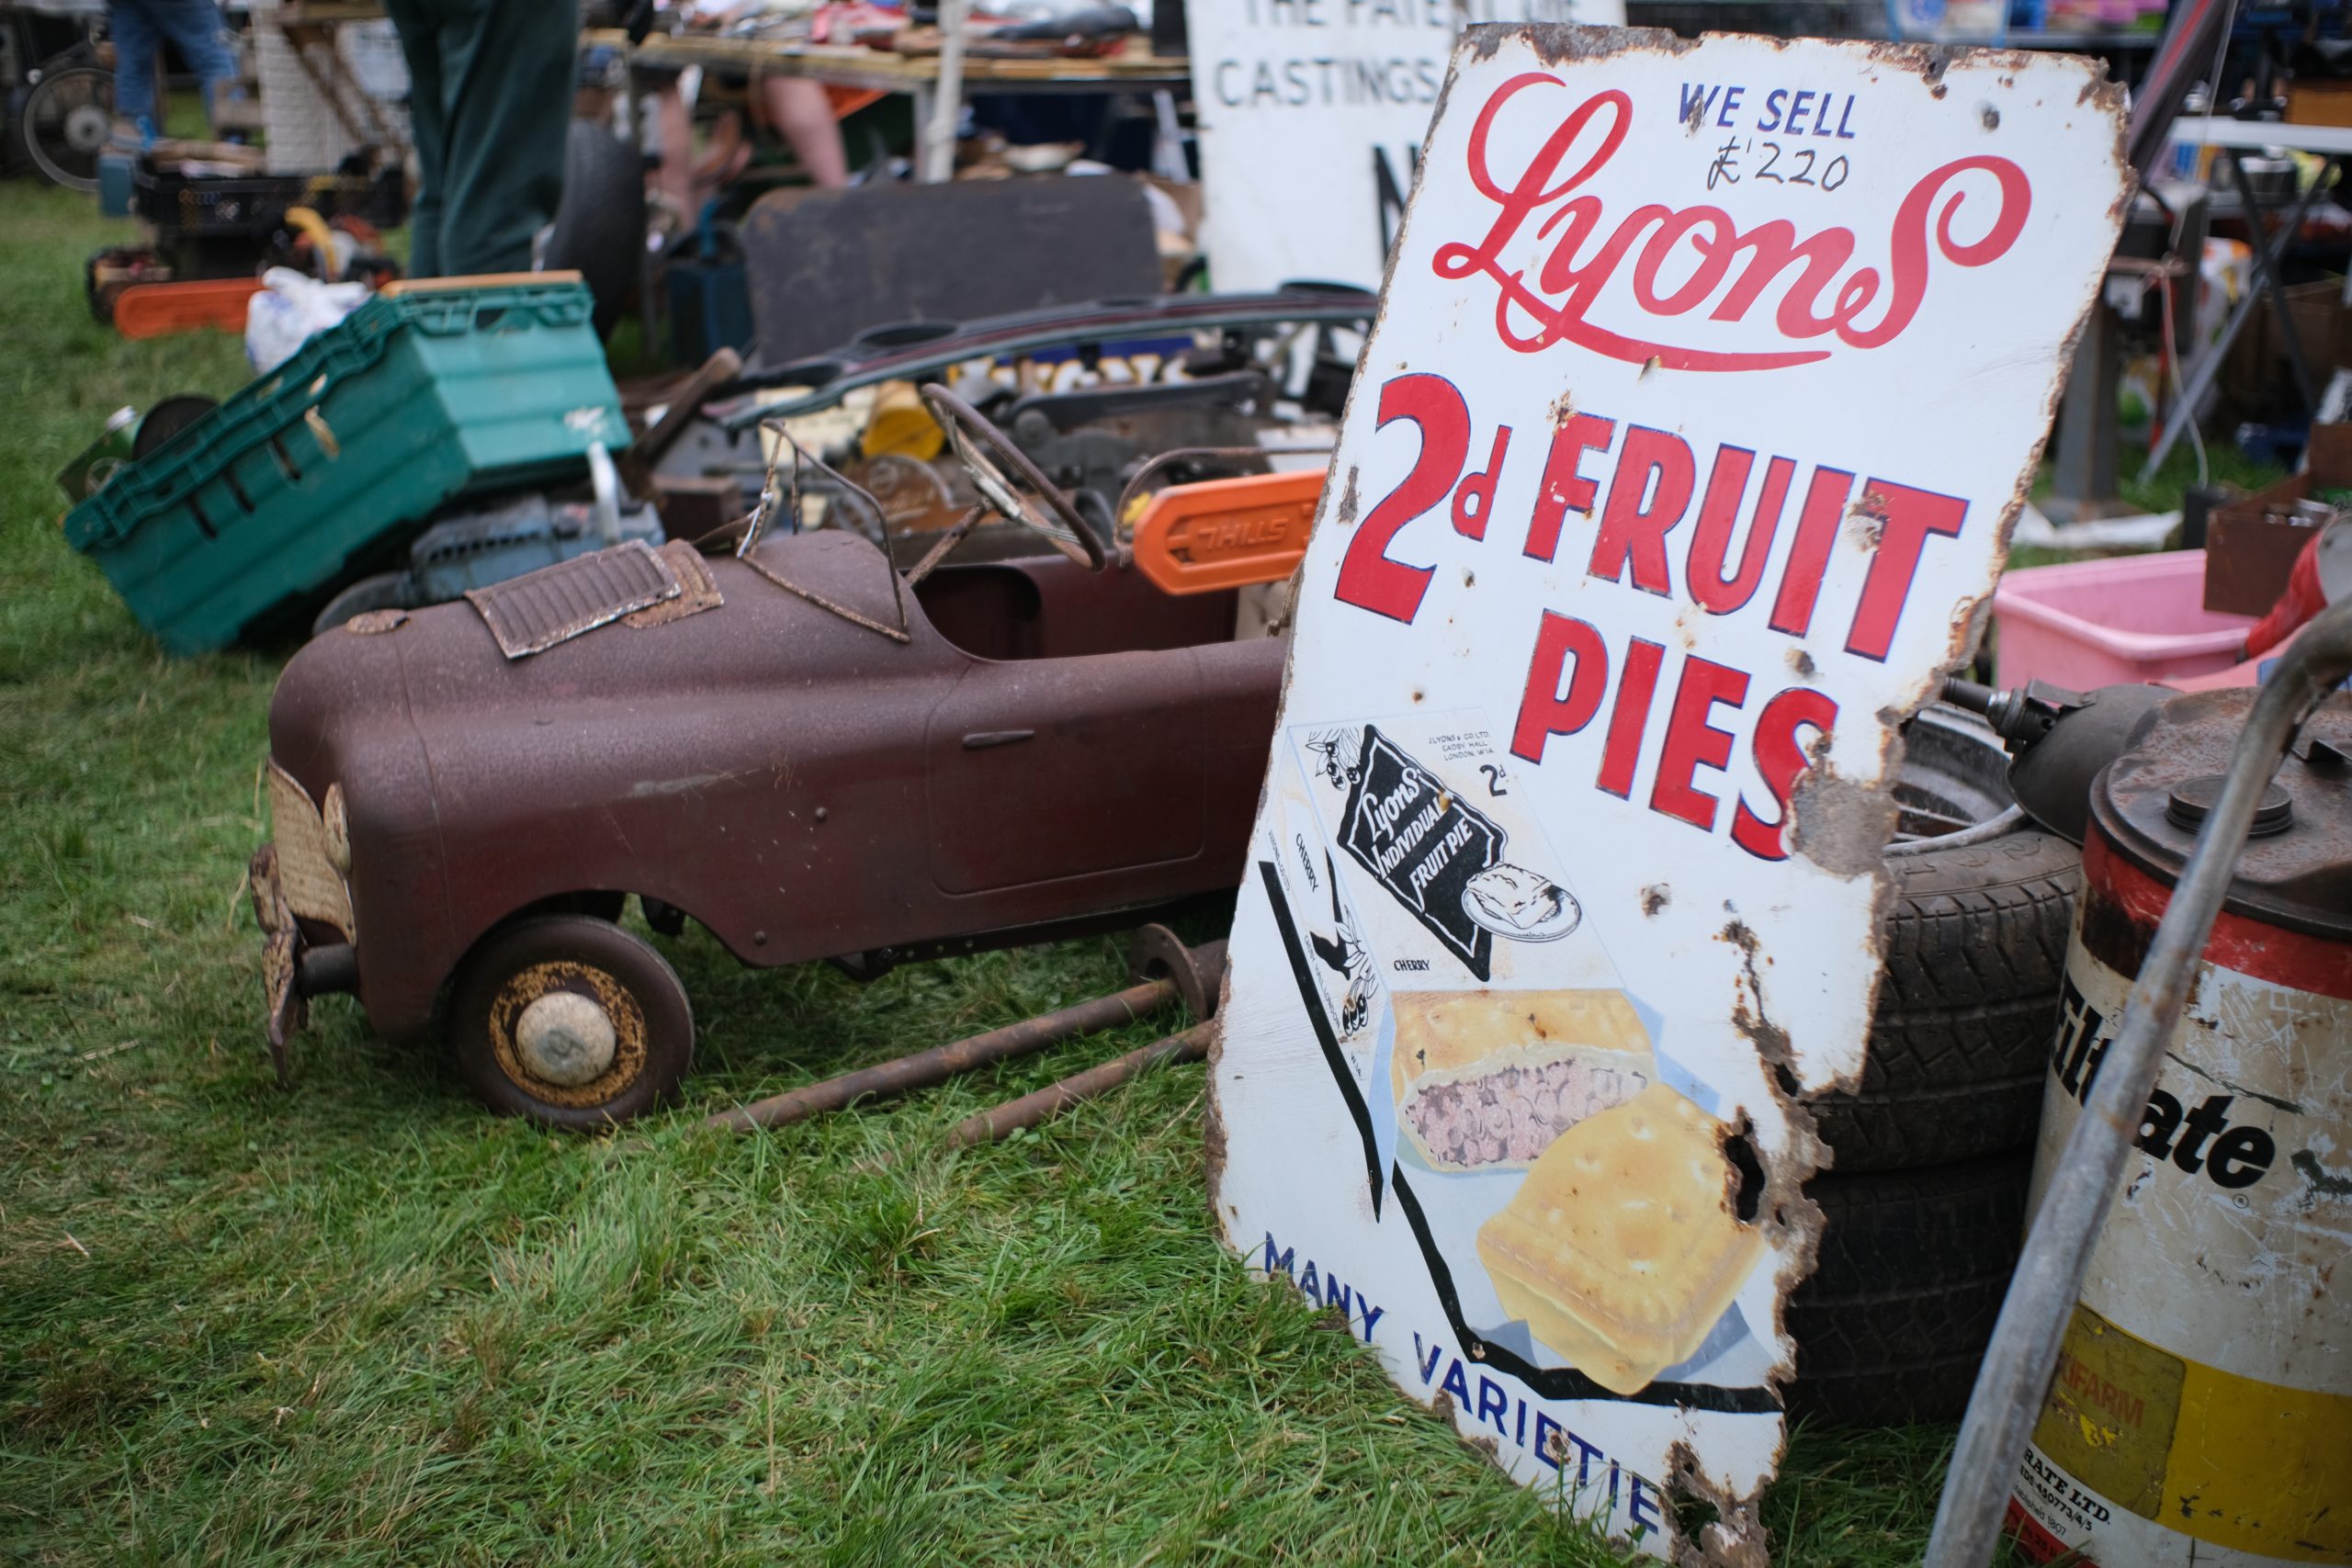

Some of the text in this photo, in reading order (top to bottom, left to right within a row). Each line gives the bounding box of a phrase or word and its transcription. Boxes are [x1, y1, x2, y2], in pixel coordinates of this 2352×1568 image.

[1215, 58, 1441, 107] CASTINGS
[1679, 83, 1856, 140] WE SELL
[1432, 72, 2032, 372] Lyons
[1333, 372, 1971, 862] 2d FRUIT PIES
[1295, 832, 1318, 893] CHERRY
[1372, 795, 1448, 880] INDIVIDUAL
[1409, 817, 1474, 912] FRUIT PIE
[1393, 959, 1430, 973] CHERRY
[1265, 1230, 1385, 1343] MANY
[2019, 1464, 2093, 1532] EDS-450773/4/5
[2024, 1447, 2068, 1495] RATE
[2047, 1516, 2068, 1536] 1807
